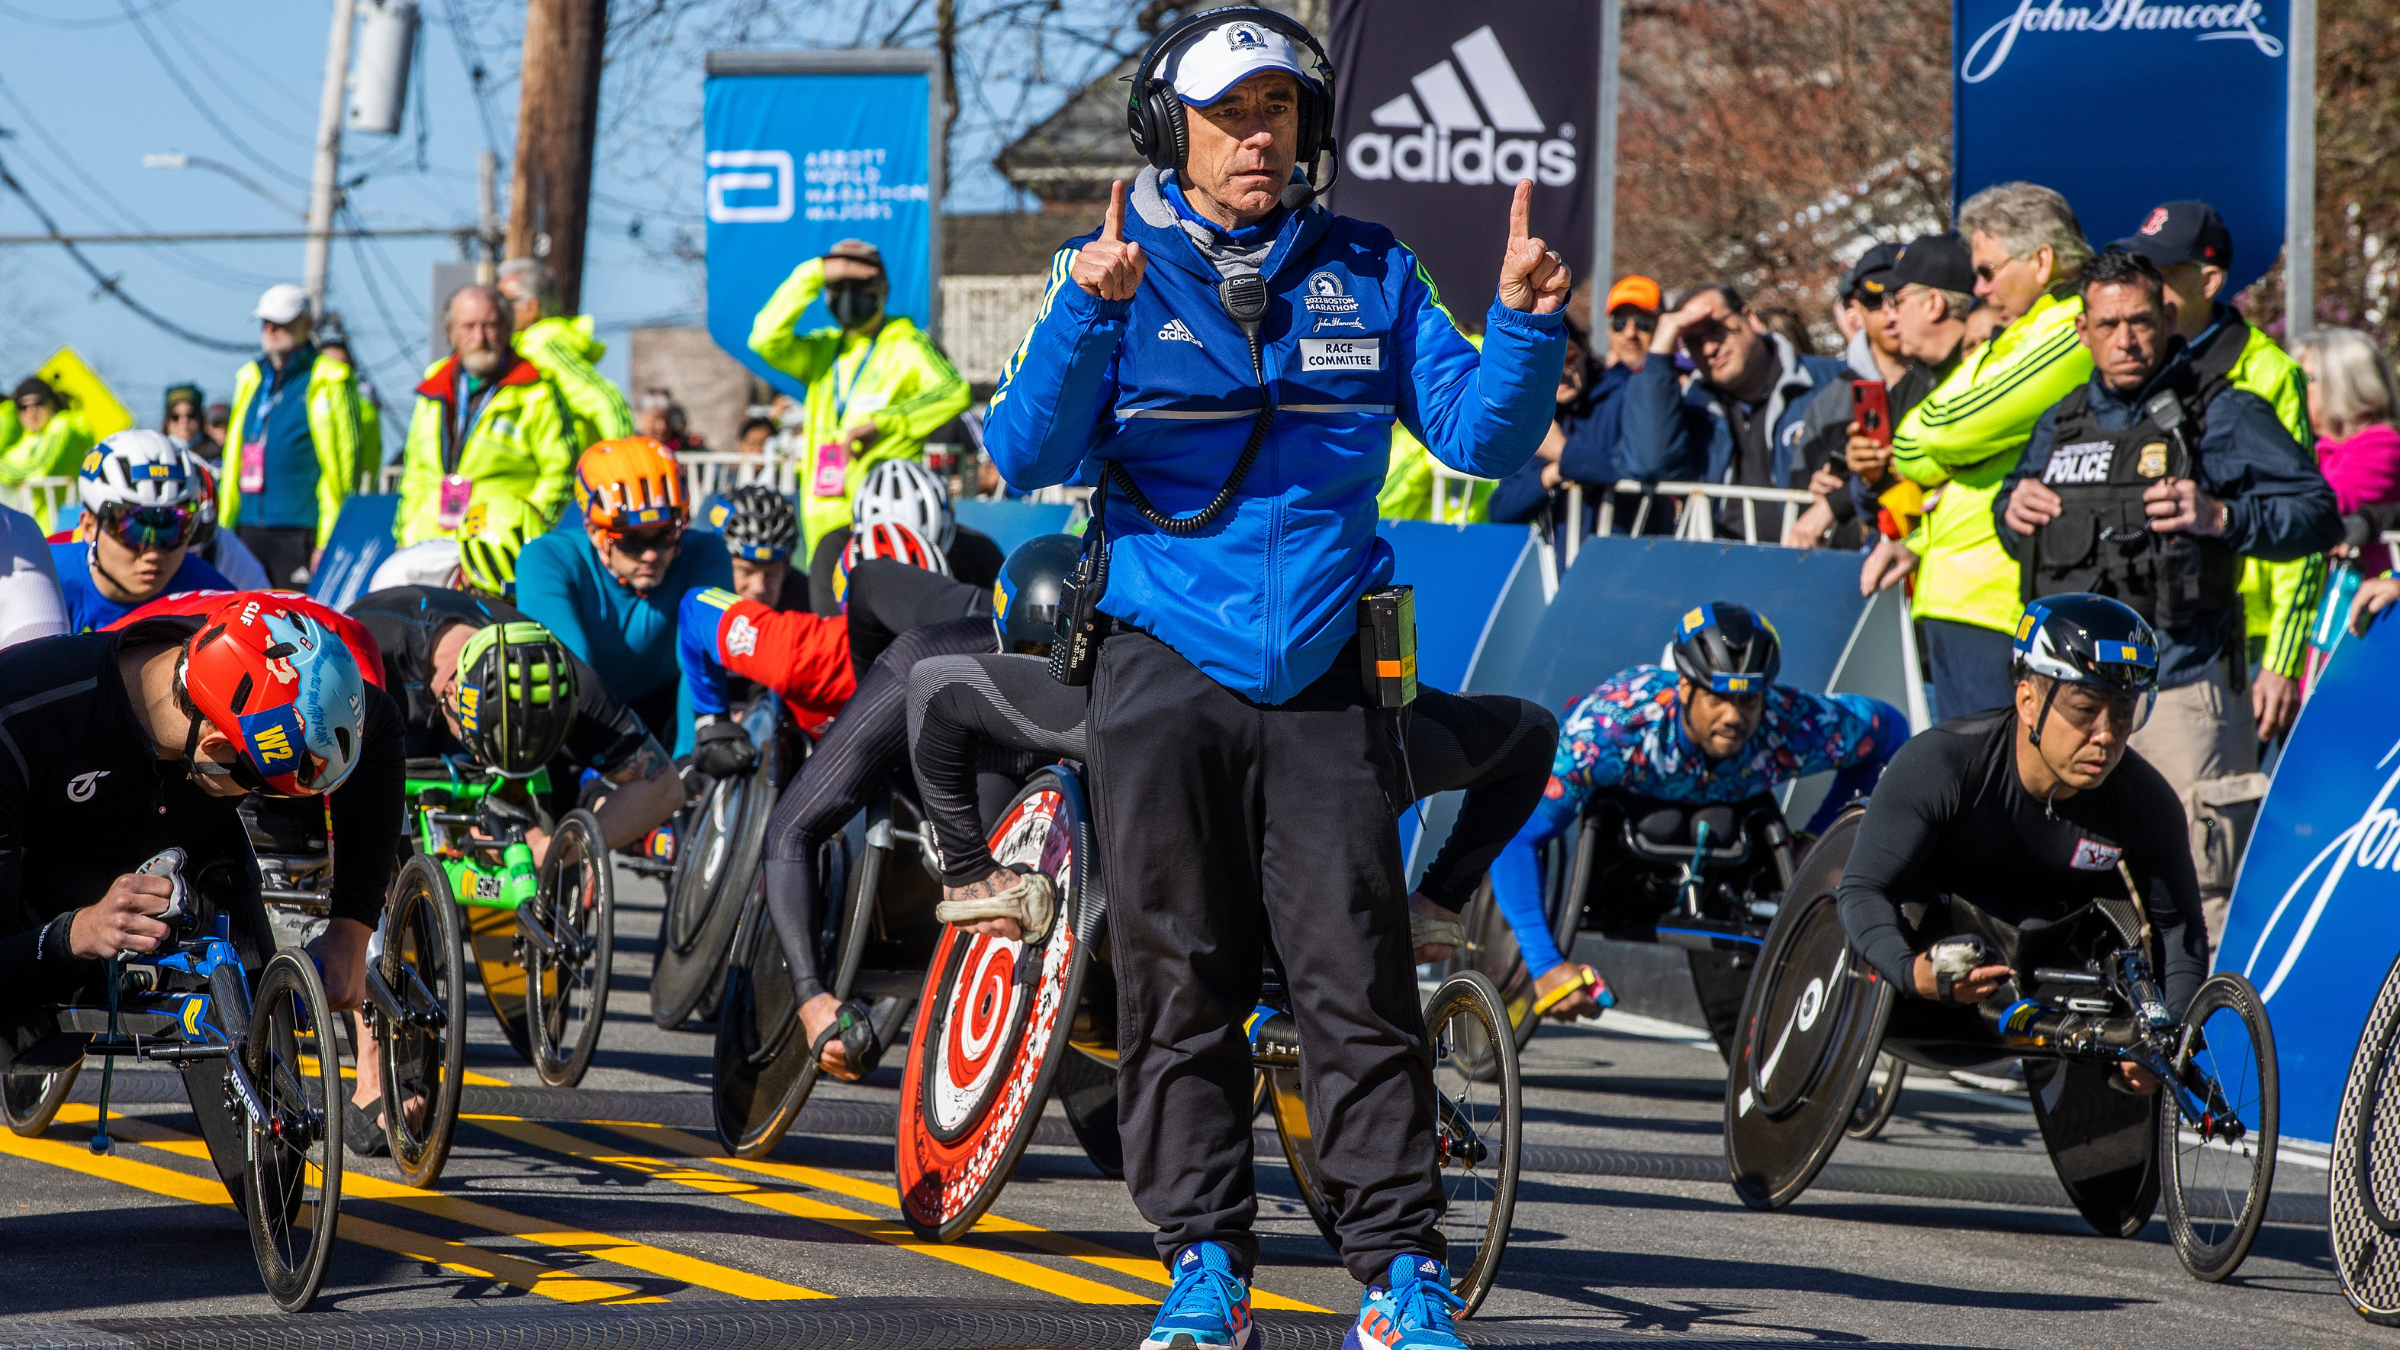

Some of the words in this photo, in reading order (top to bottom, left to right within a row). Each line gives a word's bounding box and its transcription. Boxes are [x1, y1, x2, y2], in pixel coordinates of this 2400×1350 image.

[1961, 0, 2092, 84] John
[2089, 0, 2284, 58] Hancock
[804, 149, 887, 168] ABBOTT
[1346, 123, 1577, 187] adidas
[804, 166, 882, 186] WORLD
[804, 184, 929, 204] MARATHON
[804, 202, 893, 221] MAJORS
[1304, 297, 1324, 305] 2022
[1323, 297, 1355, 305] BOSTON
[1312, 316, 1333, 333] John
[1330, 316, 1366, 330] Hancock
[1325, 343, 1354, 354] RACE
[1308, 355, 1372, 366] COMMITTEE
[2042, 451, 2113, 484] POLICE
[240, 601, 261, 627] CLIF
[254, 724, 294, 764] W2
[231, 1069, 246, 1094] TOP
[243, 1093, 260, 1124] END
